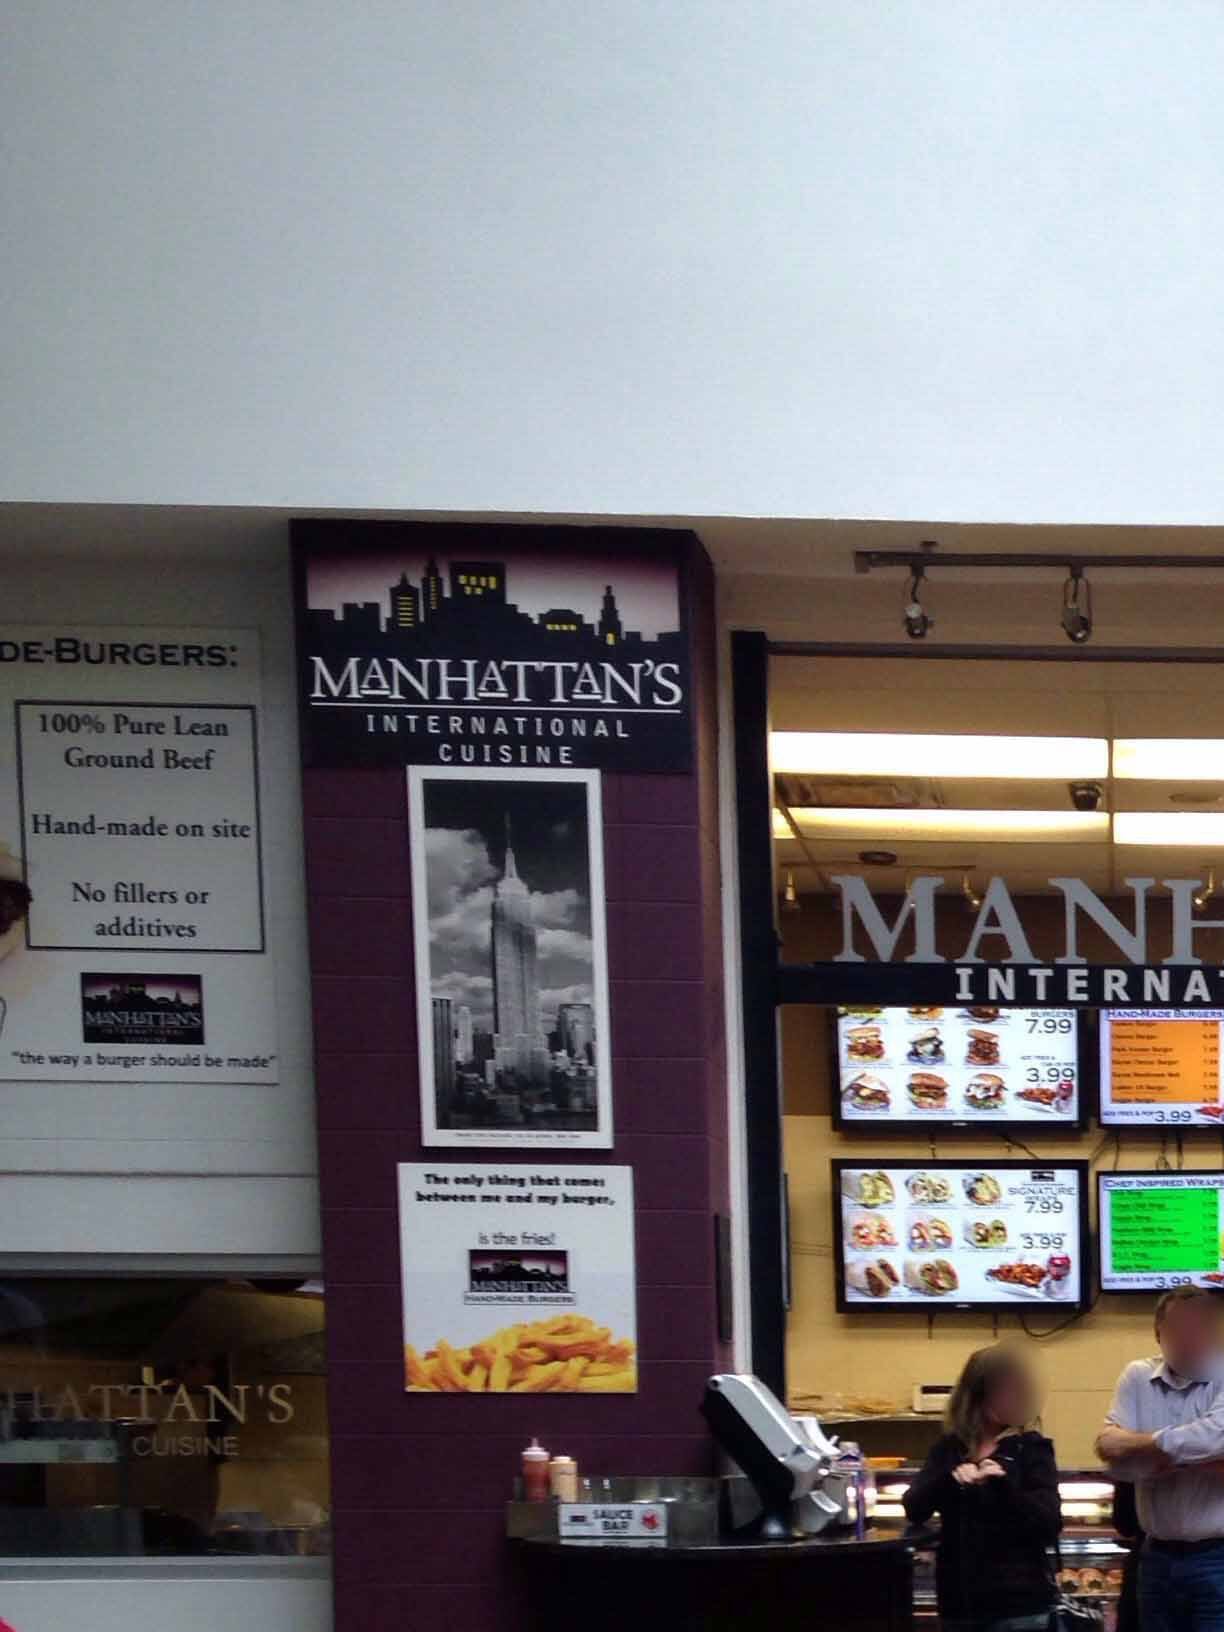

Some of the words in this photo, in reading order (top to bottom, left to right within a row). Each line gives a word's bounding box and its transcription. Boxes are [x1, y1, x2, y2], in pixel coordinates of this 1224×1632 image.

[310, 656, 684, 706] MANHATTAN'S
[39, 713, 105, 735] 100%
[113, 714, 166, 736] Pure
[174, 716, 229, 737] Lean
[367, 715, 630, 738] INTERNATIONAL
[64, 747, 155, 770] Ground
[163, 748, 215, 771] Beef
[439, 744, 573, 764] CUISINE
[31, 814, 169, 838] Hand-made
[175, 822, 205, 838] on
[212, 817, 251, 839] site
[71, 882, 106, 903] No
[114, 882, 178, 905] fillers
[185, 889, 209, 905] or
[95, 917, 197, 939] additives
[1025, 1018, 1072, 1034] 7.99
[50, 1055, 79, 1068] way
[83, 1056, 92, 1065] a
[97, 1053, 144, 1069] burger
[150, 1053, 200, 1067] should
[204, 1054, 223, 1067] be
[1026, 1067, 1075, 1083] 3.99
[1155, 1111, 1192, 1123] 3.99
[424, 1173, 449, 1185] The
[454, 1174, 484, 1187] only
[488, 1175, 525, 1188] thing
[530, 1176, 561, 1187] that
[565, 1178, 605, 1187] comes
[416, 1191, 476, 1203] between
[481, 1194, 501, 1203] me
[506, 1192, 533, 1203] and
[537, 1195, 558, 1206] my
[1024, 1200, 1064, 1214] 7.99
[492, 1231, 518, 1245] the
[1023, 1236, 1063, 1250] 3.99
[132, 1435, 241, 1457] CUISINE
[593, 1509, 633, 1520] SAUCE
[602, 1520, 630, 1531] BAR
